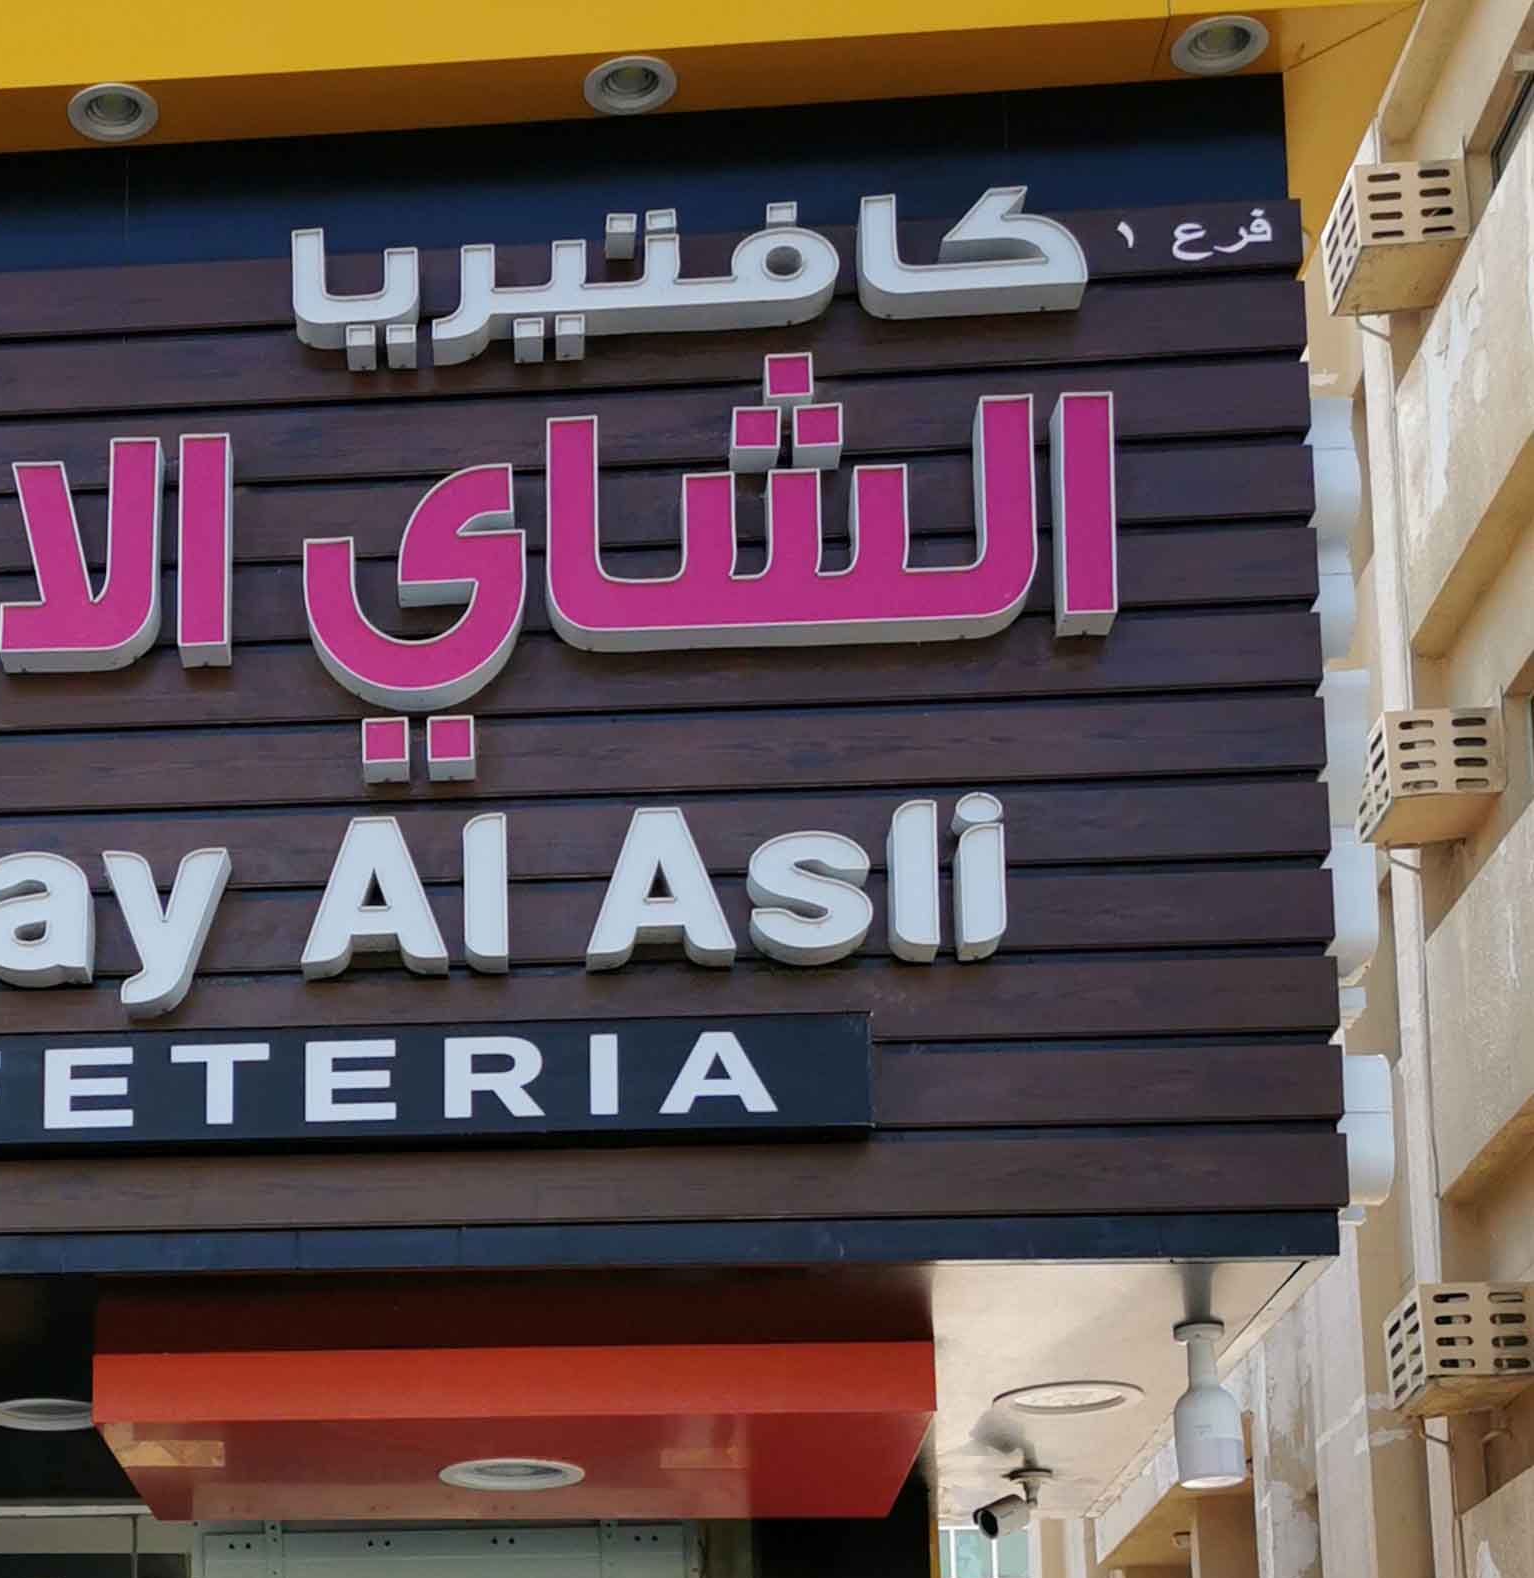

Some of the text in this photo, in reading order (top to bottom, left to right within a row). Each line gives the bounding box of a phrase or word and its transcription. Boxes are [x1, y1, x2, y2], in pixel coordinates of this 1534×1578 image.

[1171, 207, 1273, 261] فرع
[300, 812, 509, 980] Al
[585, 791, 1007, 970] Asli
